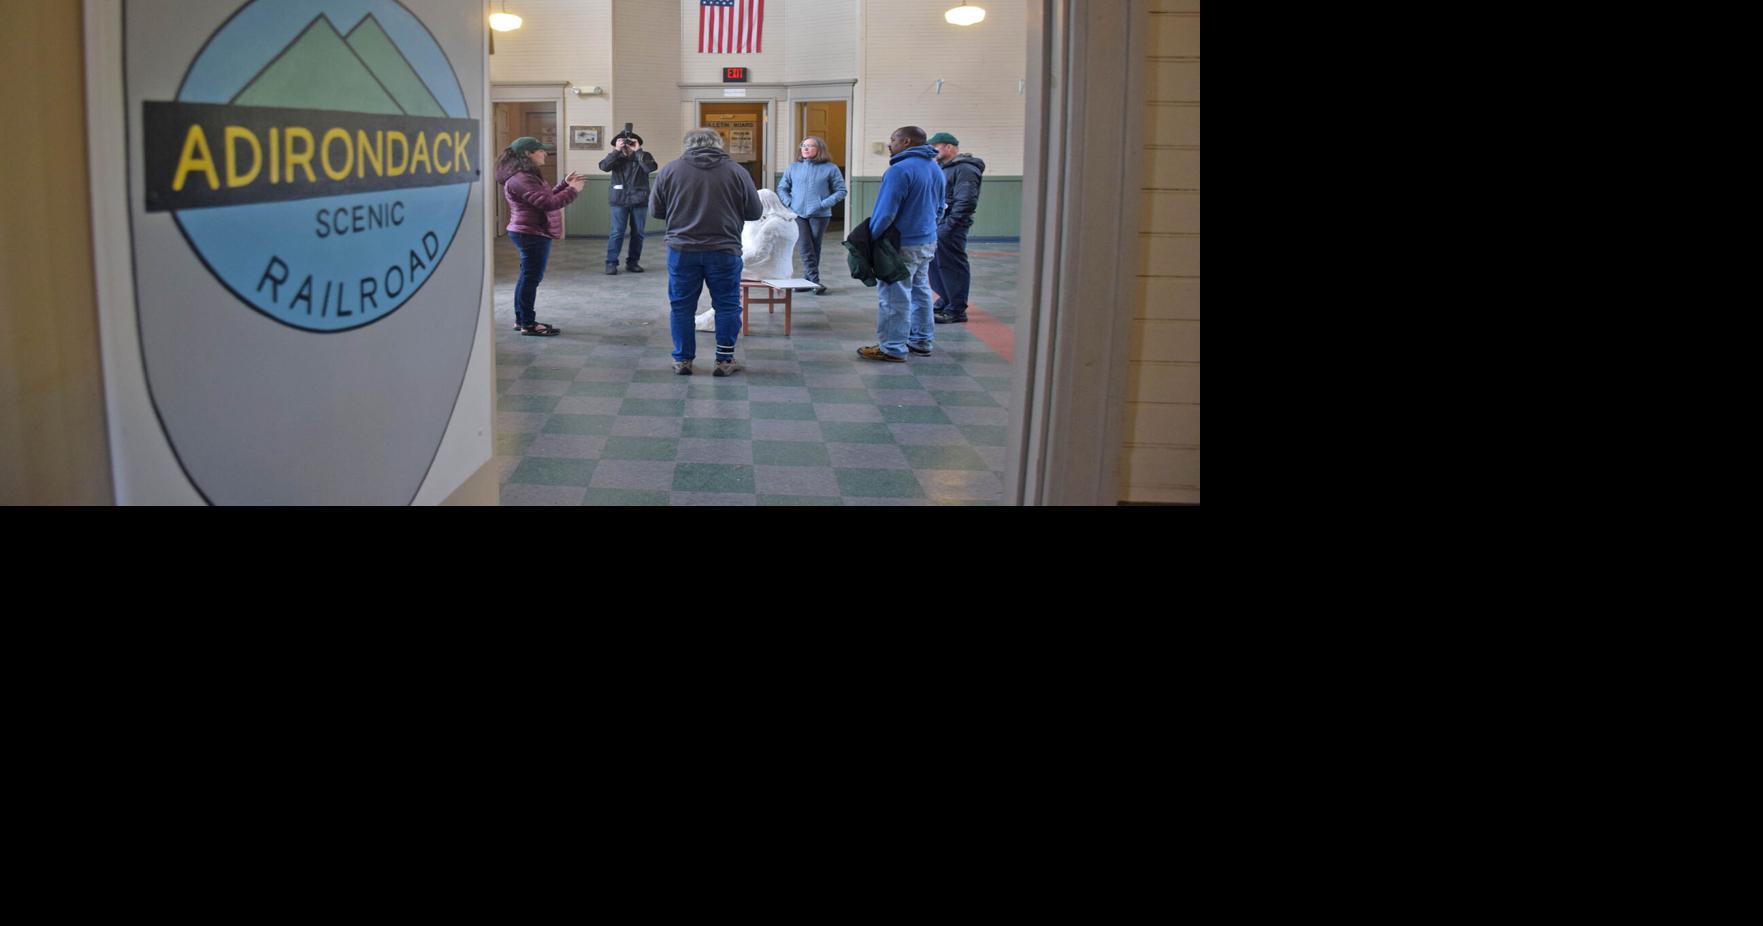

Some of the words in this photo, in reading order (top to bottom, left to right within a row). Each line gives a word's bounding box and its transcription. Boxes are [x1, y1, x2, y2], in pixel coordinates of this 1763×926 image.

[727, 68, 742, 78] EXIT
[172, 123, 471, 192] ADIRONDACK
[315, 200, 405, 239] SCENIC
[256, 229, 440, 318] RAILROAD
